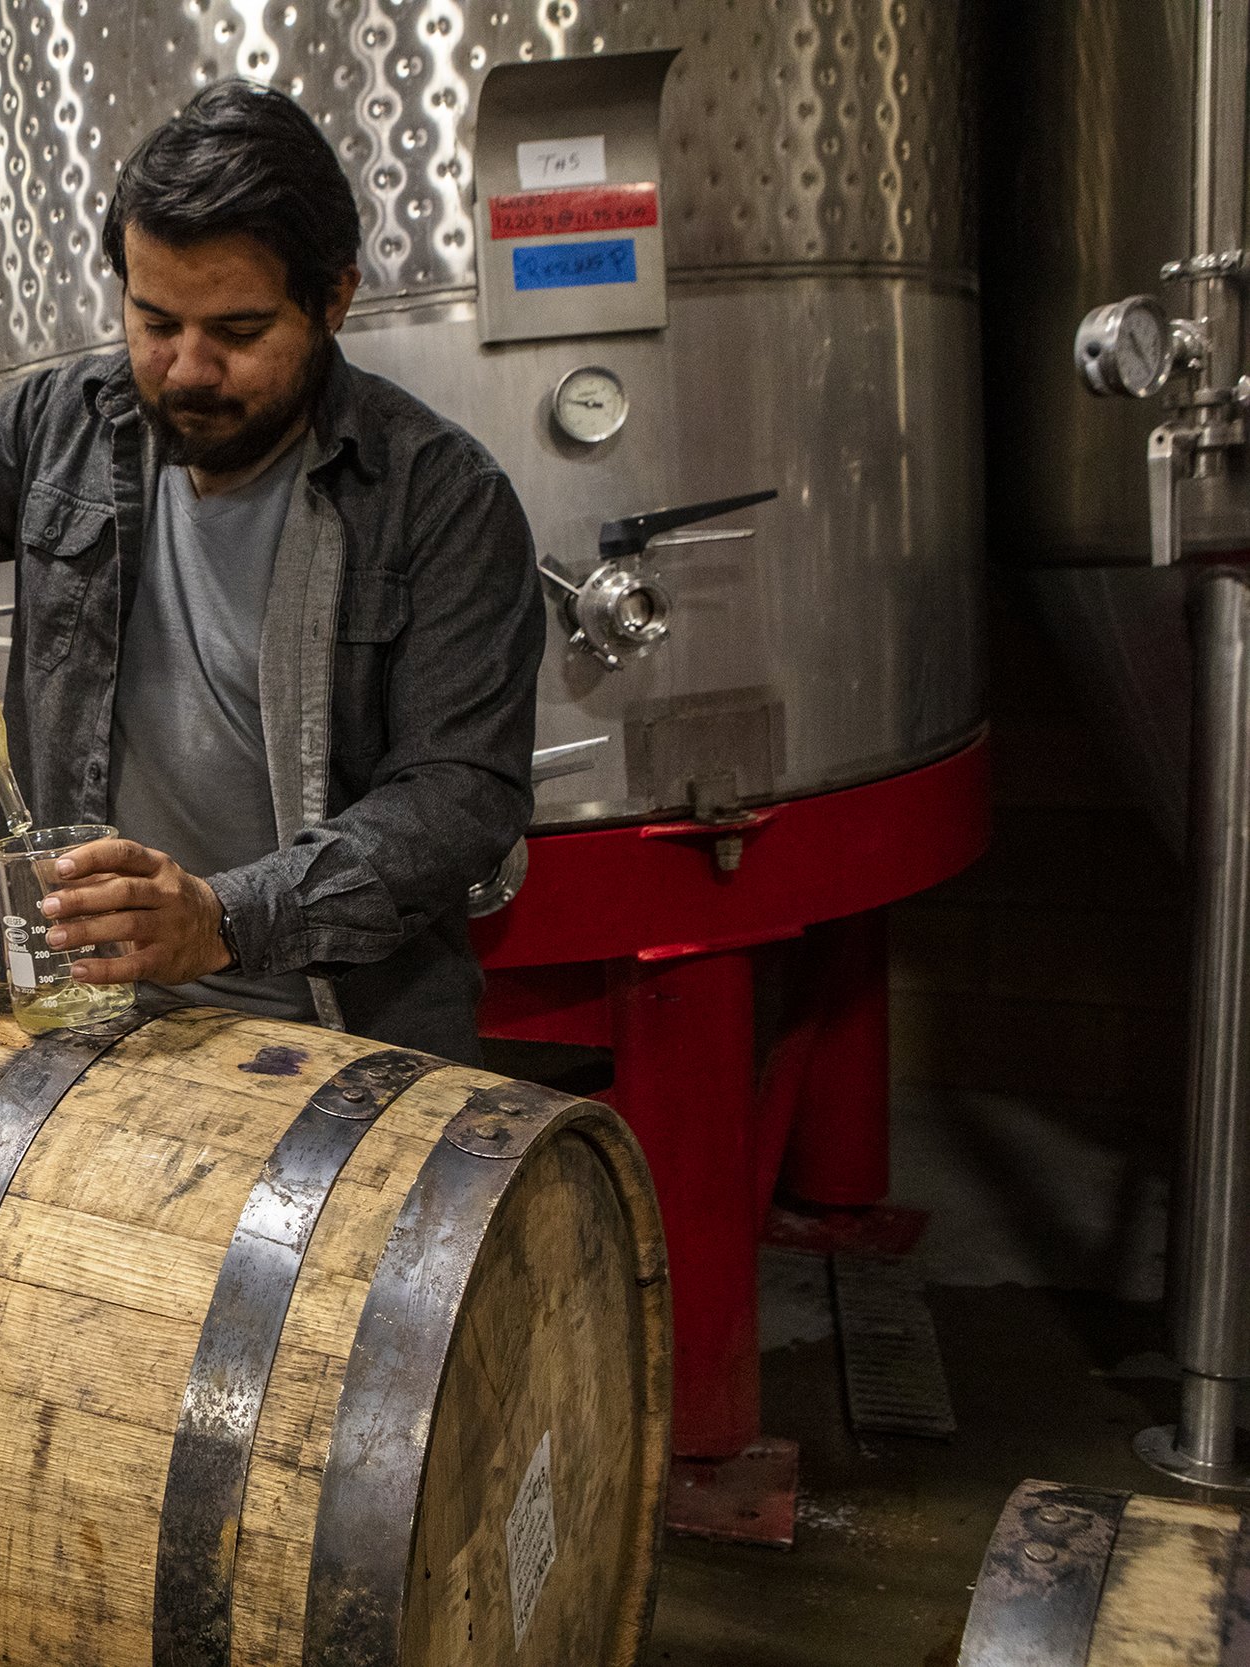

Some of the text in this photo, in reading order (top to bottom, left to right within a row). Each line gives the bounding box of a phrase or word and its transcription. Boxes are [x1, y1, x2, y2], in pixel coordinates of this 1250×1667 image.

[31, 926, 46, 934] 100
[34, 951, 50, 959] 200
[38, 975, 54, 984] 300
[42, 1000, 58, 1008] 400
